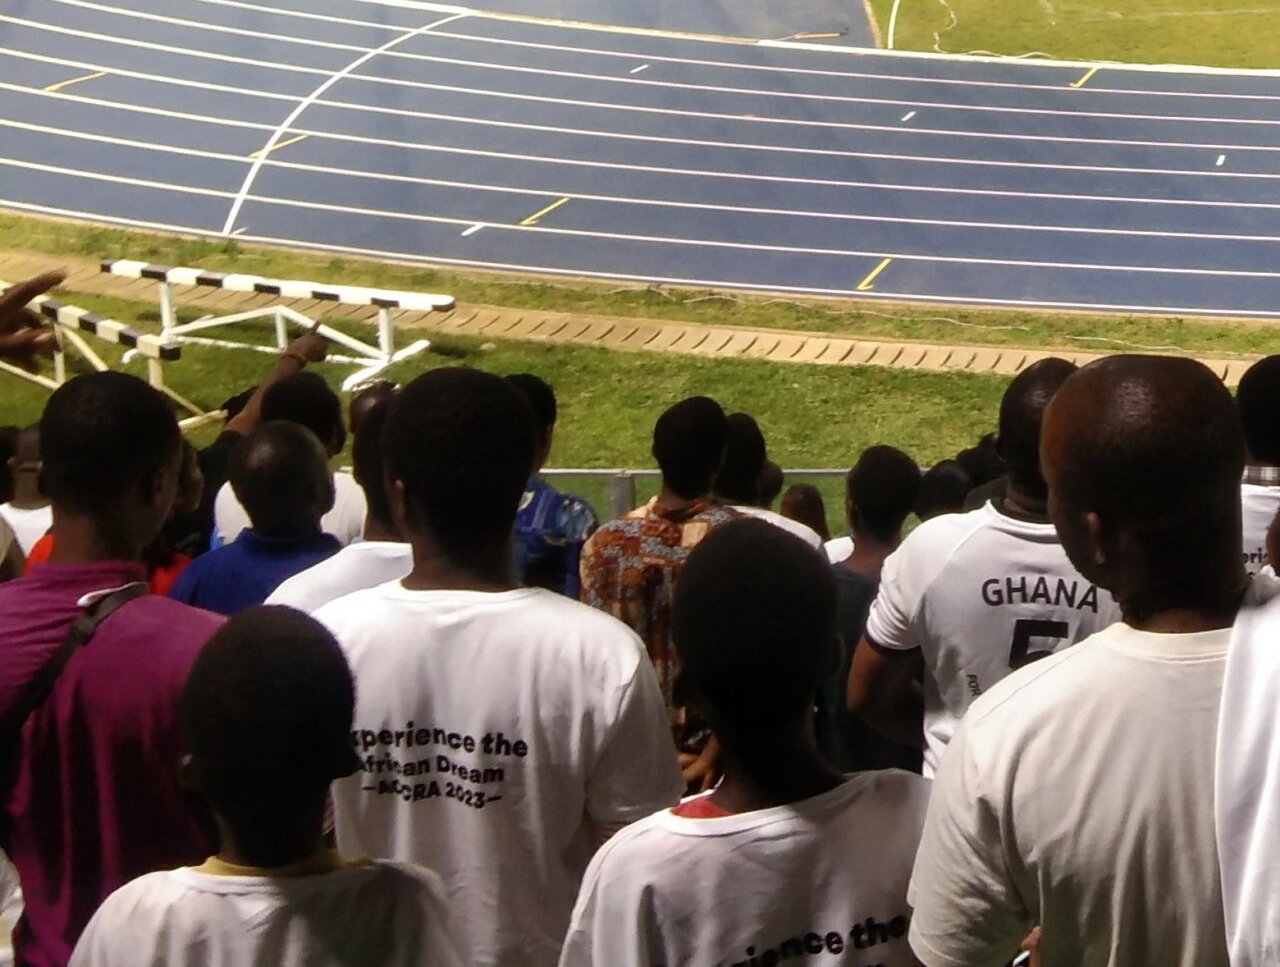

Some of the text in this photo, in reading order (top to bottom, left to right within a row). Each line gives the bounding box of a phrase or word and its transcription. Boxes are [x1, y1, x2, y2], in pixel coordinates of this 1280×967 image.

[981, 577, 1098, 613] GHANA
[351, 721, 528, 757] xperience the
[437, 756, 504, 783] Dream
